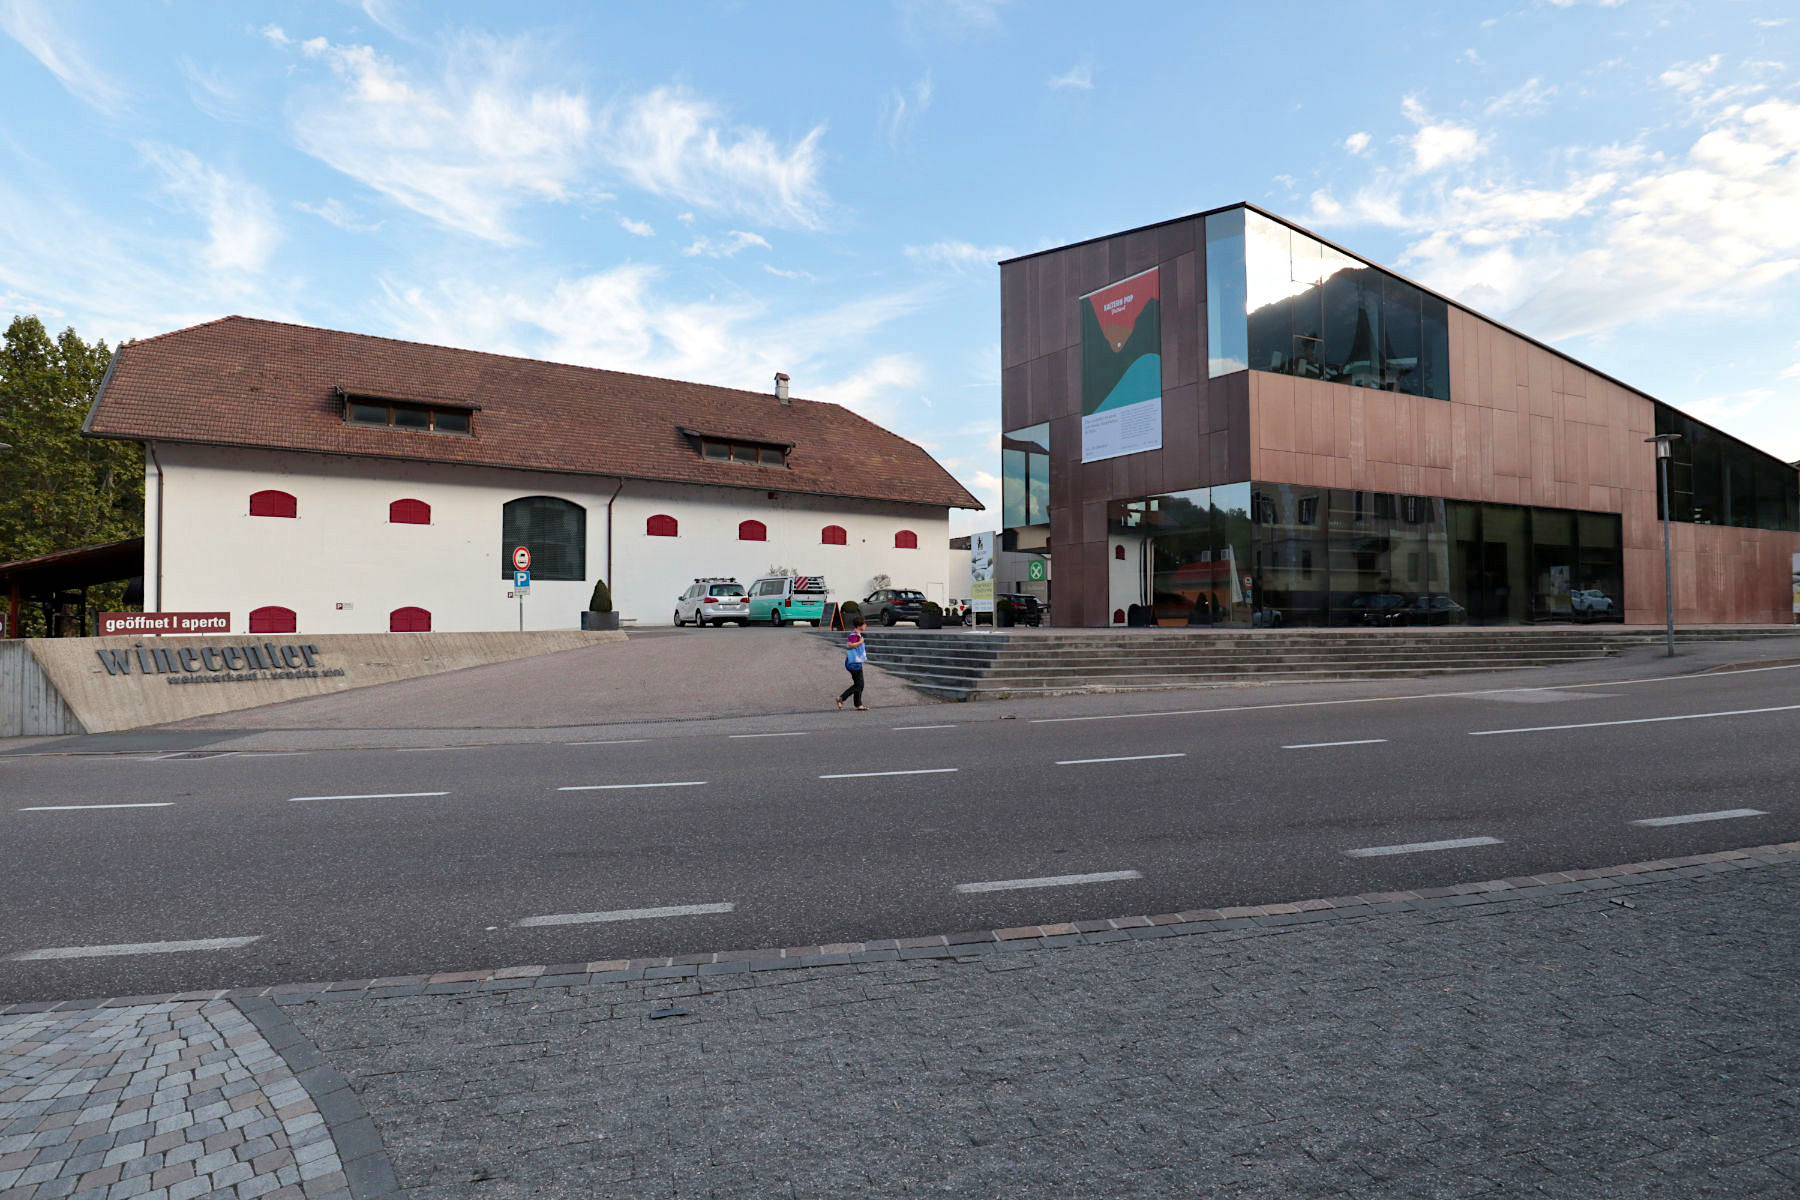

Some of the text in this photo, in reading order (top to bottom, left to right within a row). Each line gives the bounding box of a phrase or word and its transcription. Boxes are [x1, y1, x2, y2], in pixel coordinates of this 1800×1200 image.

[517, 572, 527, 587] P
[105, 616, 169, 632] geöffnet
[181, 617, 227, 631] aperto
[97, 642, 320, 676] winecenter
[166, 671, 258, 685] weinverkauf
